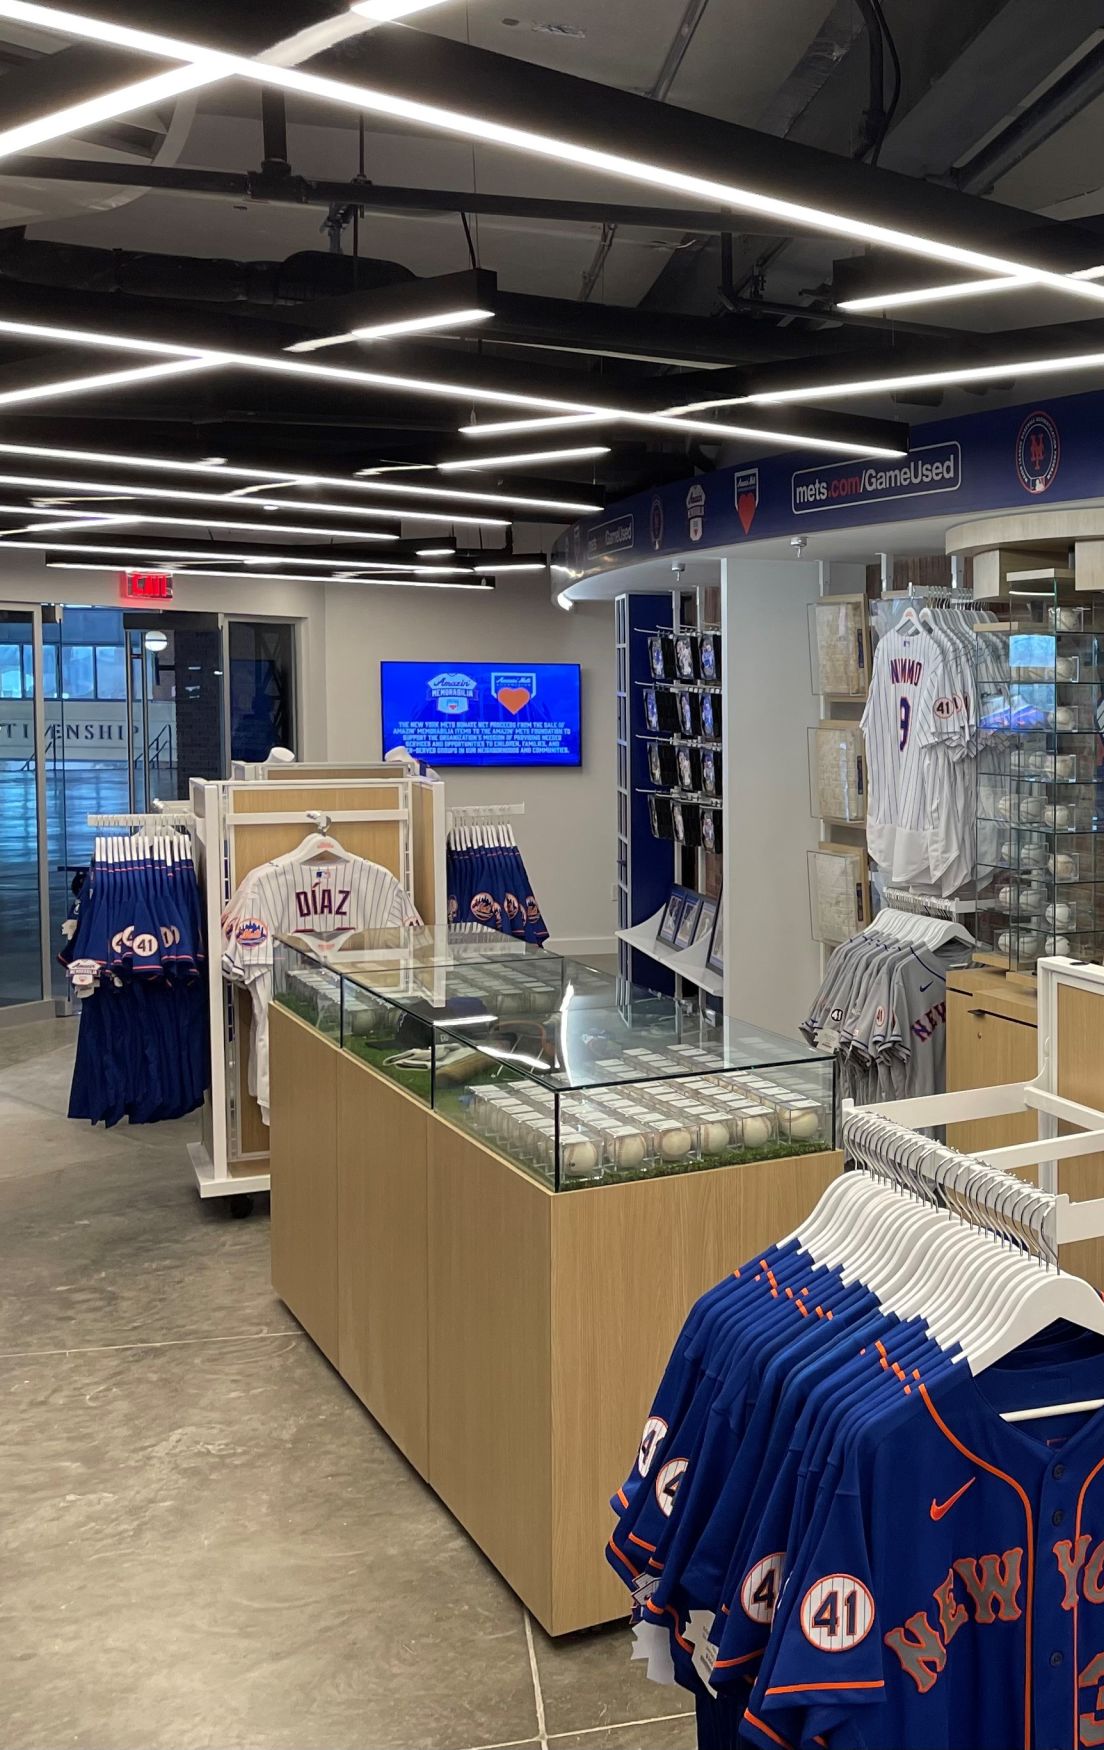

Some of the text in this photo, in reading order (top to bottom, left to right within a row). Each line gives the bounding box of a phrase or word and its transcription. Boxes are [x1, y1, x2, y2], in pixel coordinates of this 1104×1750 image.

[796, 454, 954, 503] mets.com/GameUsed
[900, 696, 911, 752] 9
[936, 701, 950, 714] 41
[295, 881, 351, 918] DÍAZ
[137, 939, 153, 952] 41
[812, 1590, 857, 1637] 41
[883, 1547, 1024, 1694] NEW
